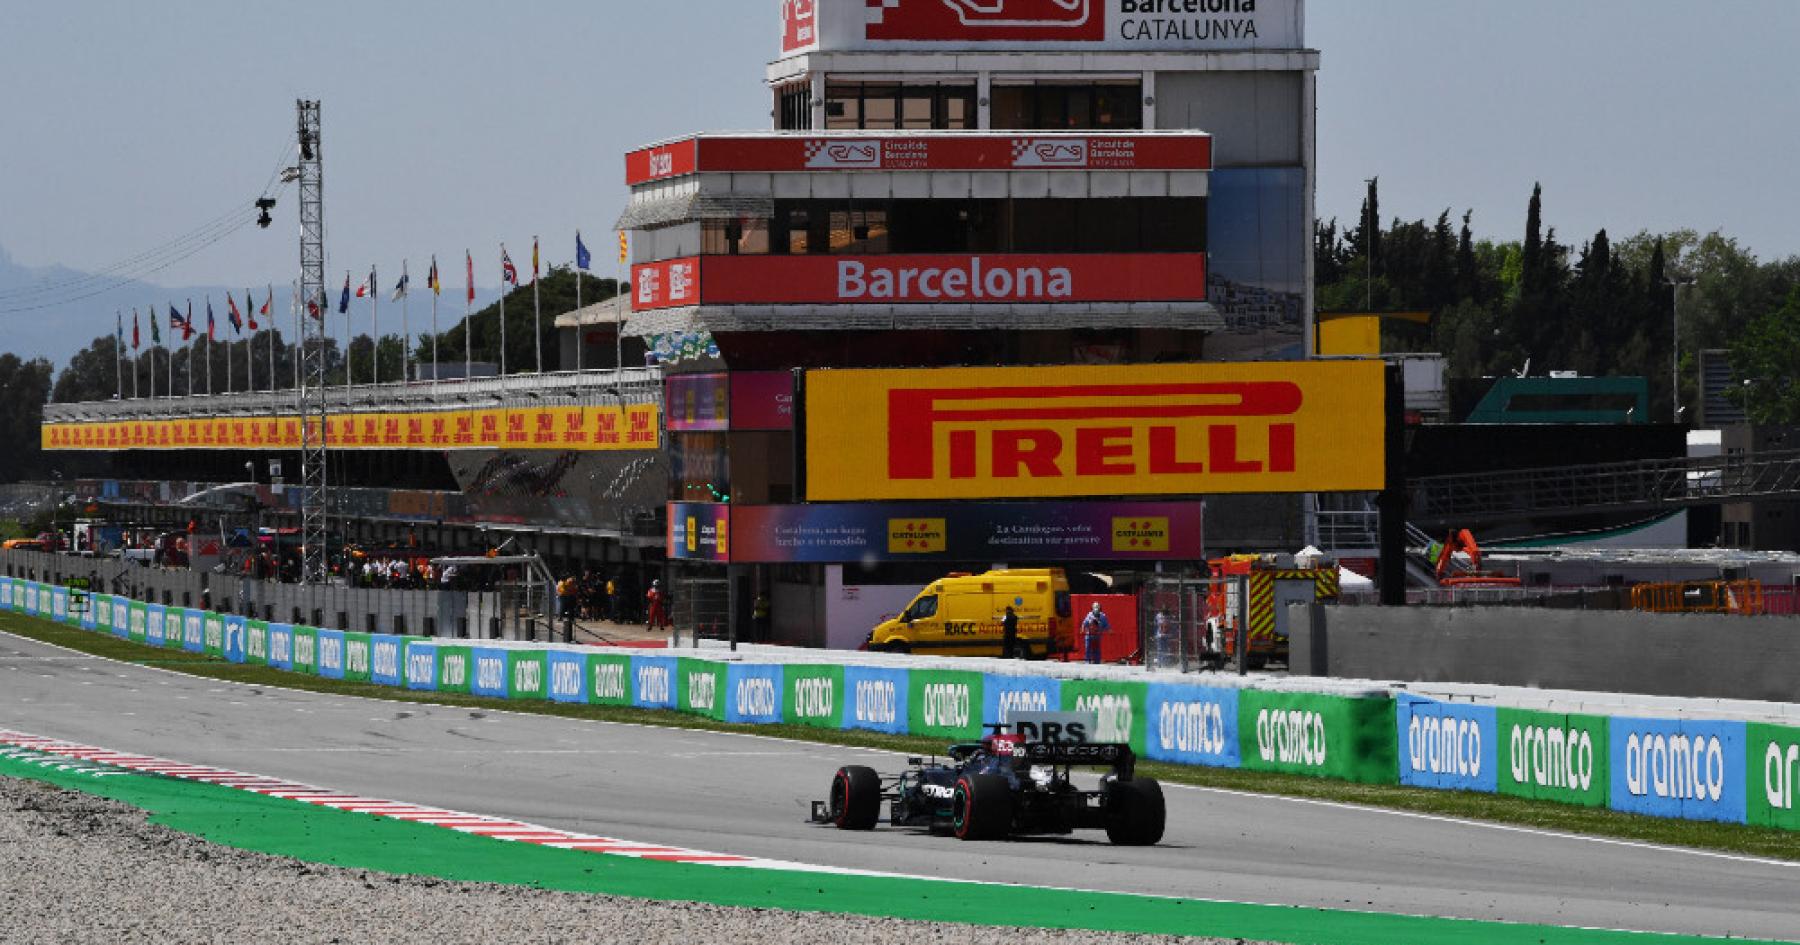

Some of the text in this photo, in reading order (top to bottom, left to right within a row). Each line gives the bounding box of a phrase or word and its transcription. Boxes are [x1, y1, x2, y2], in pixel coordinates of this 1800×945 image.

[1121, 19, 1258, 40] CATALUNYA
[837, 257, 1072, 298] Barcelona
[888, 381, 1303, 479] PIRELLI
[944, 622, 977, 636] RACC
[1016, 721, 1086, 743] DRS
[1160, 701, 1225, 755] aramco
[1257, 708, 1326, 766] aramco
[1409, 713, 1481, 778] aramco
[1511, 723, 1592, 791] aramco
[1626, 732, 1723, 802] aramco
